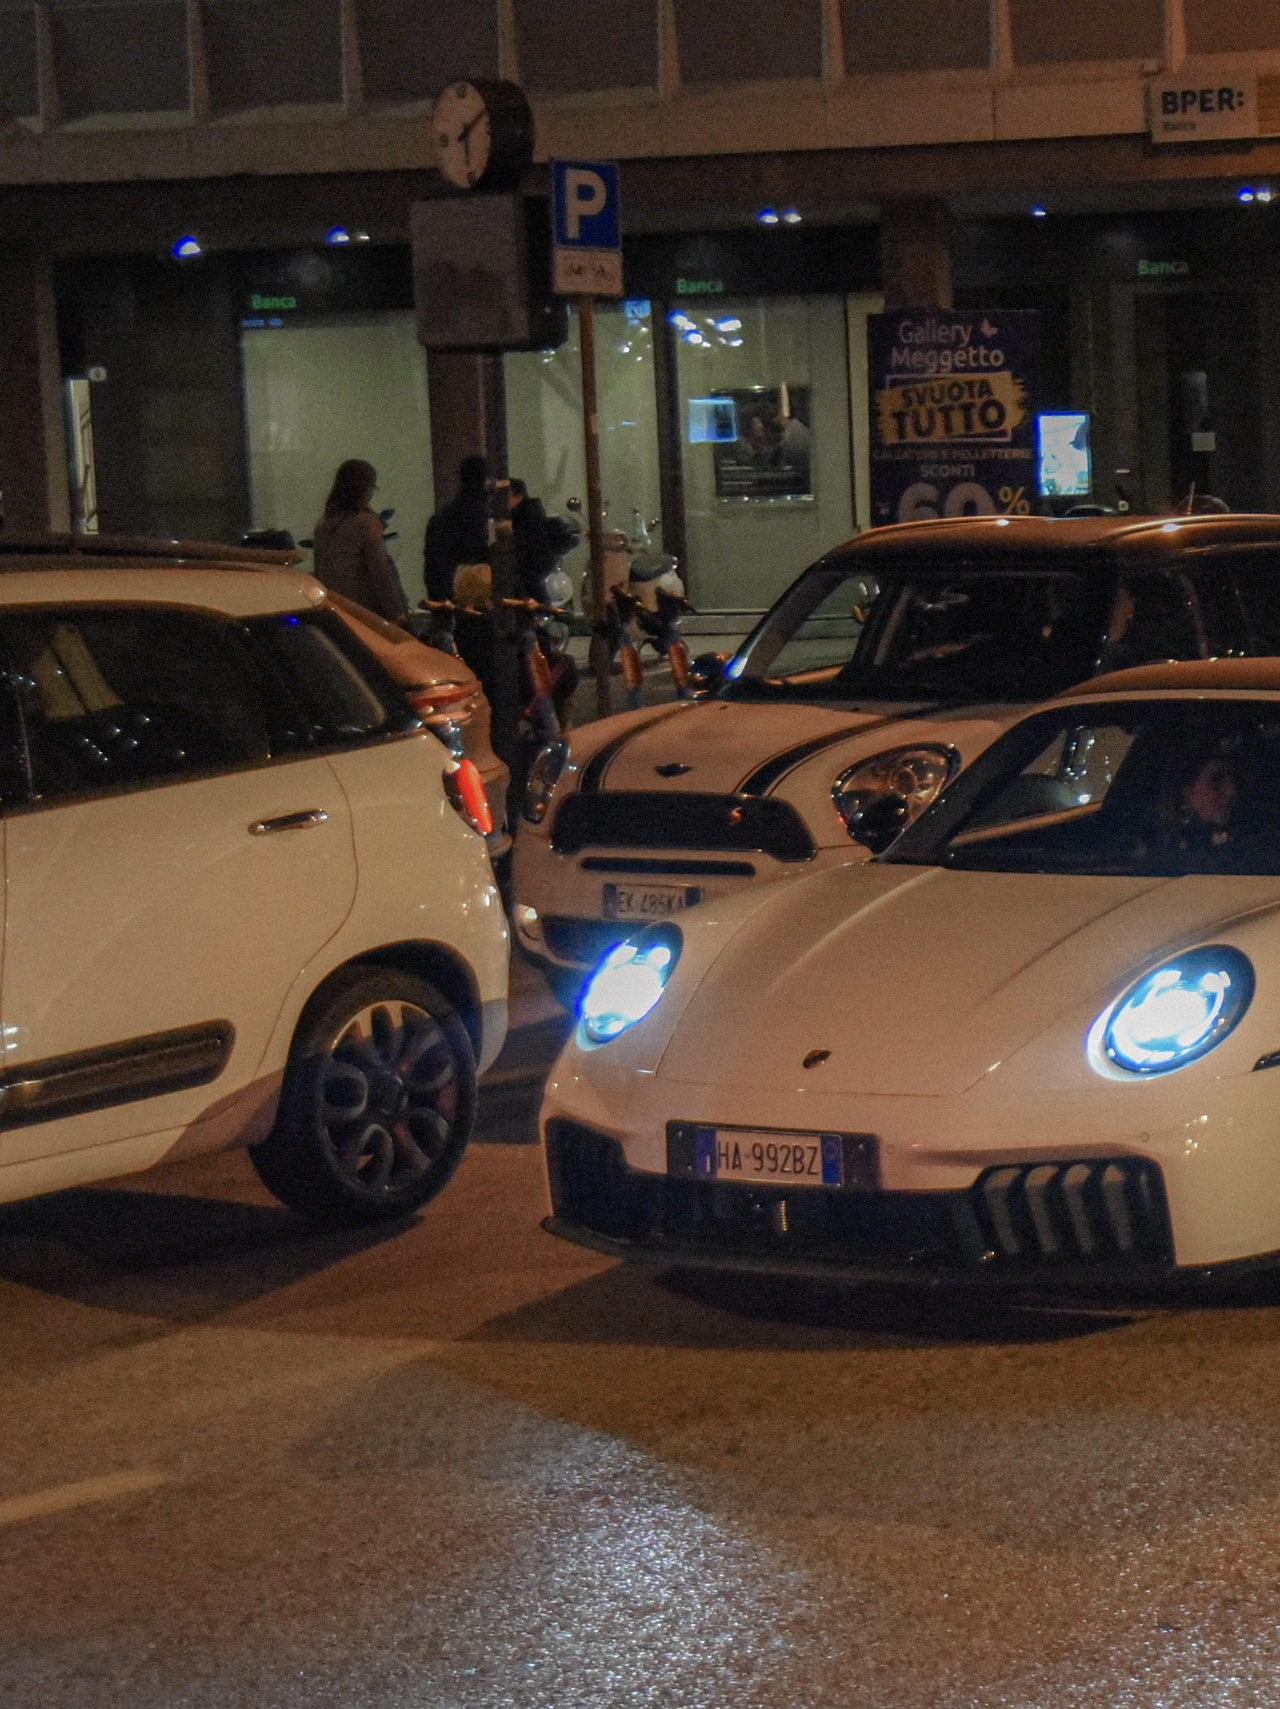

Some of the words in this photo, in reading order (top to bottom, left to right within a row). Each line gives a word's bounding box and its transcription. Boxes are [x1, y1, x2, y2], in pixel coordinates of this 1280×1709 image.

[565, 167, 607, 239] P
[1138, 259, 1189, 275] Banca
[676, 278, 724, 294] Banca
[251, 294, 297, 310] Banca
[898, 319, 973, 348] Gallery
[889, 346, 1005, 374] Meggetto
[901, 379, 994, 406] SVUOTA
[891, 398, 1006, 440] TUTTO
[920, 464, 976, 478] SCONTI
[718, 1140, 742, 1170] HA
[752, 1141, 819, 1176] 992BZ
